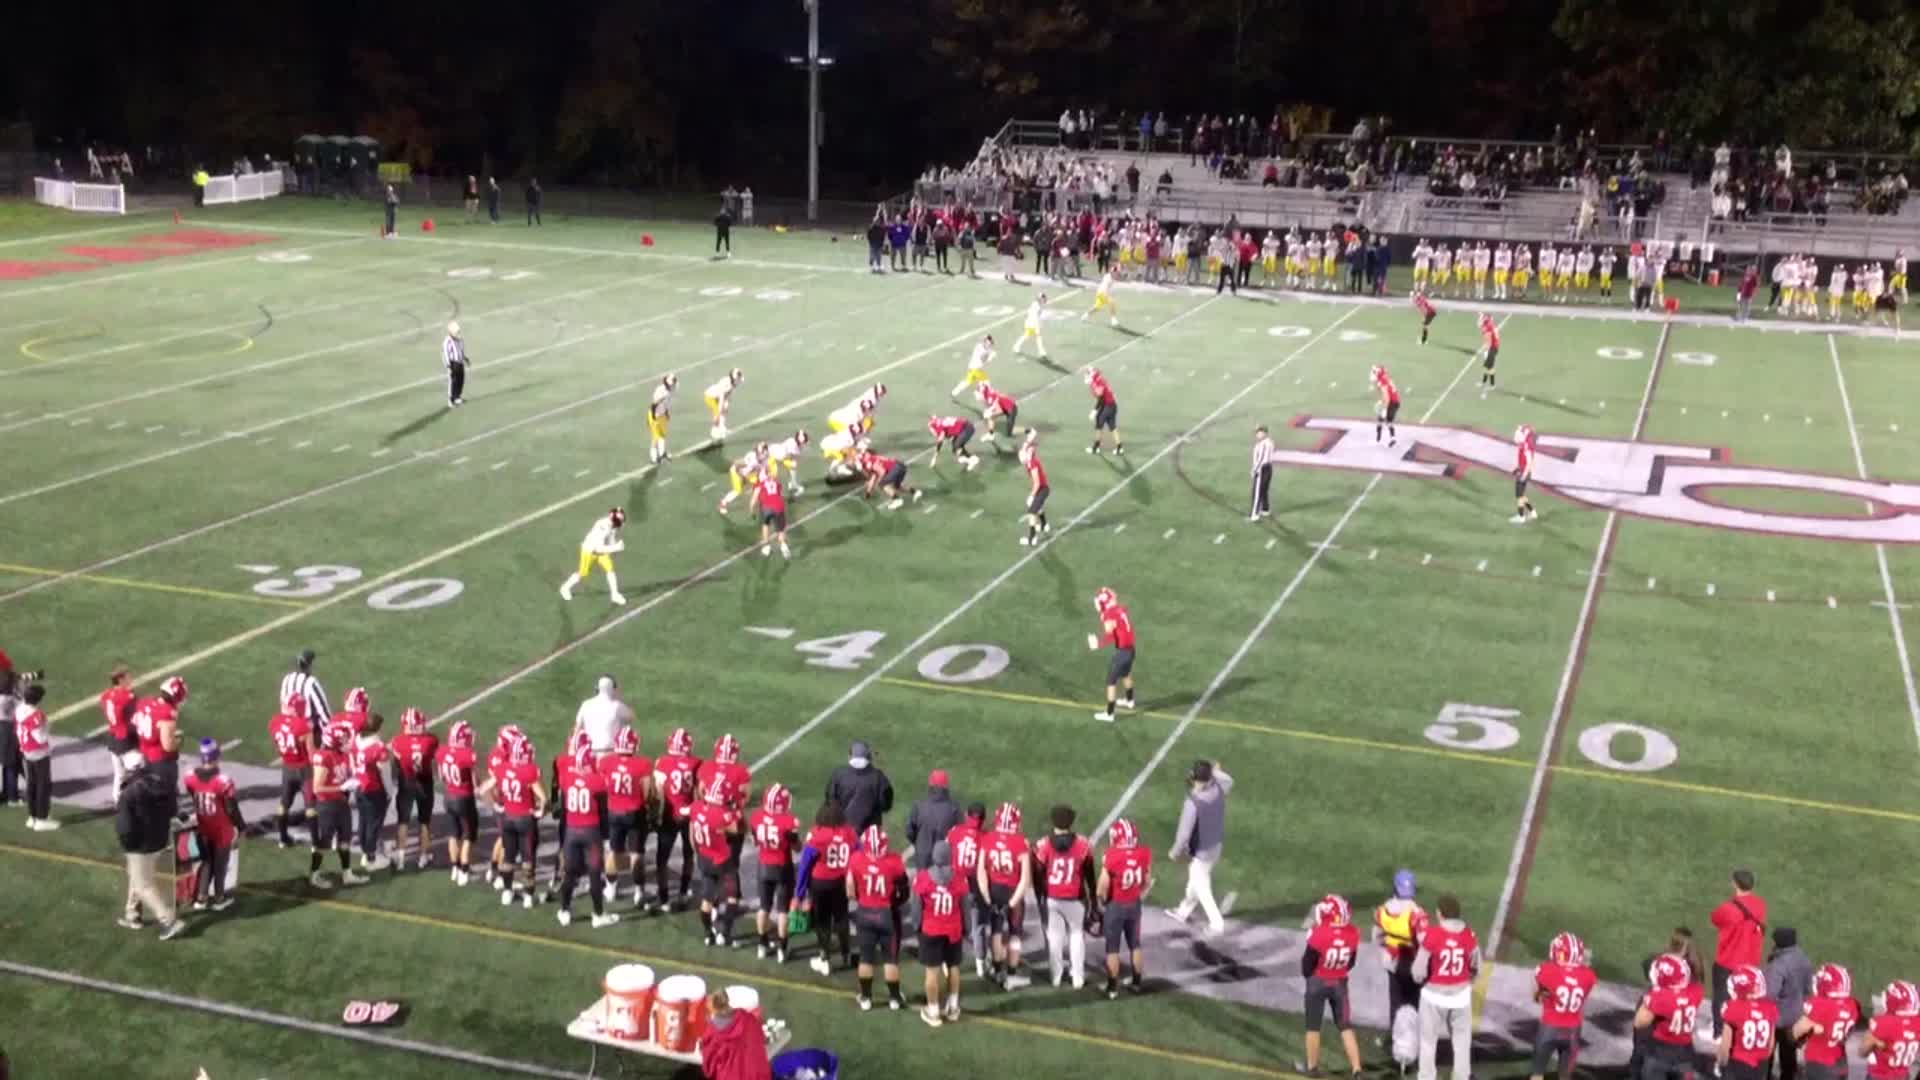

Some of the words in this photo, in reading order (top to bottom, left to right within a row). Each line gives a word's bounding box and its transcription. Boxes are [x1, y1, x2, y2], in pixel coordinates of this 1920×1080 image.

[611, 772, 632, 795] 73
[567, 787, 590, 814] 80
[1438, 947, 1465, 977] 25
[1555, 986, 1585, 1014] 36
[1669, 1006, 1697, 1035] 43
[1742, 1019, 1771, 1050] 83
